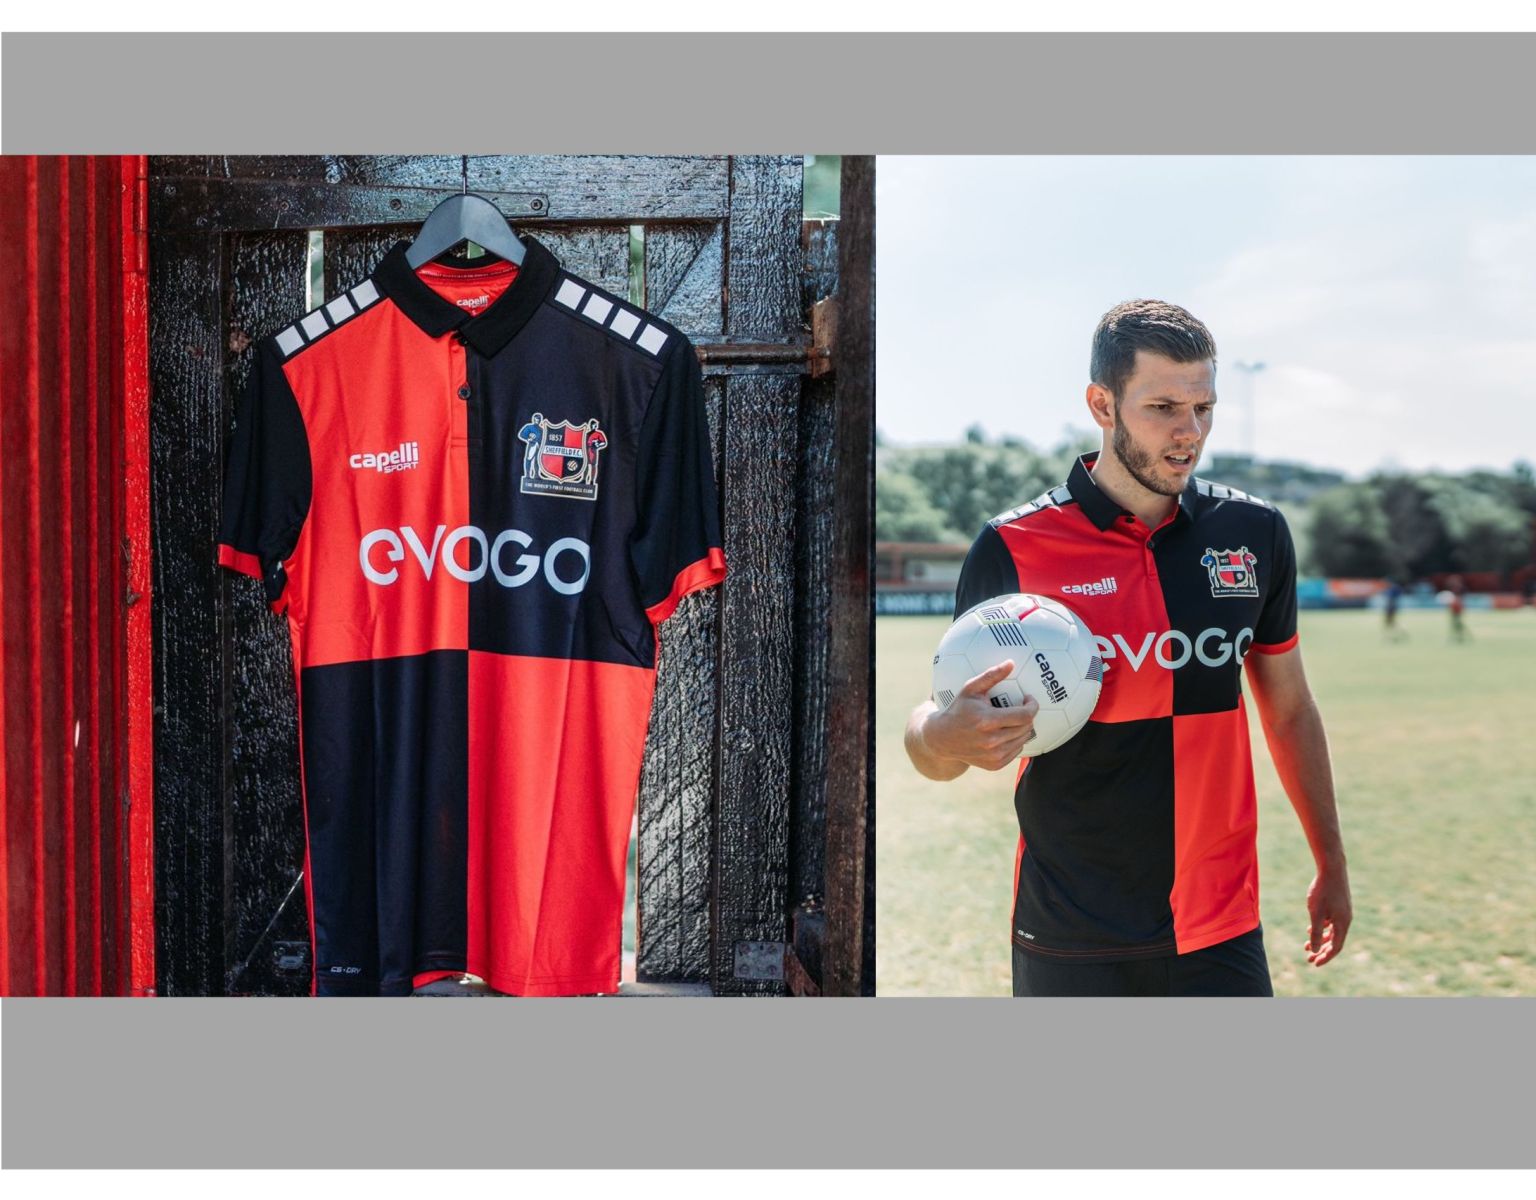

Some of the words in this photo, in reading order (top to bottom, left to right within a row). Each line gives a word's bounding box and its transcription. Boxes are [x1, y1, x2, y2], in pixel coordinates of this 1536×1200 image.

[548, 433, 563, 442] 1857
[349, 441, 419, 472] capelli
[545, 447, 572, 456] SHEFFIELD
[384, 461, 419, 473] SPORT
[1061, 577, 1117, 596] capelli
[1089, 588, 1118, 596] SPORT
[1035, 652, 1068, 703] capelli
[1041, 678, 1057, 704] SPORT
